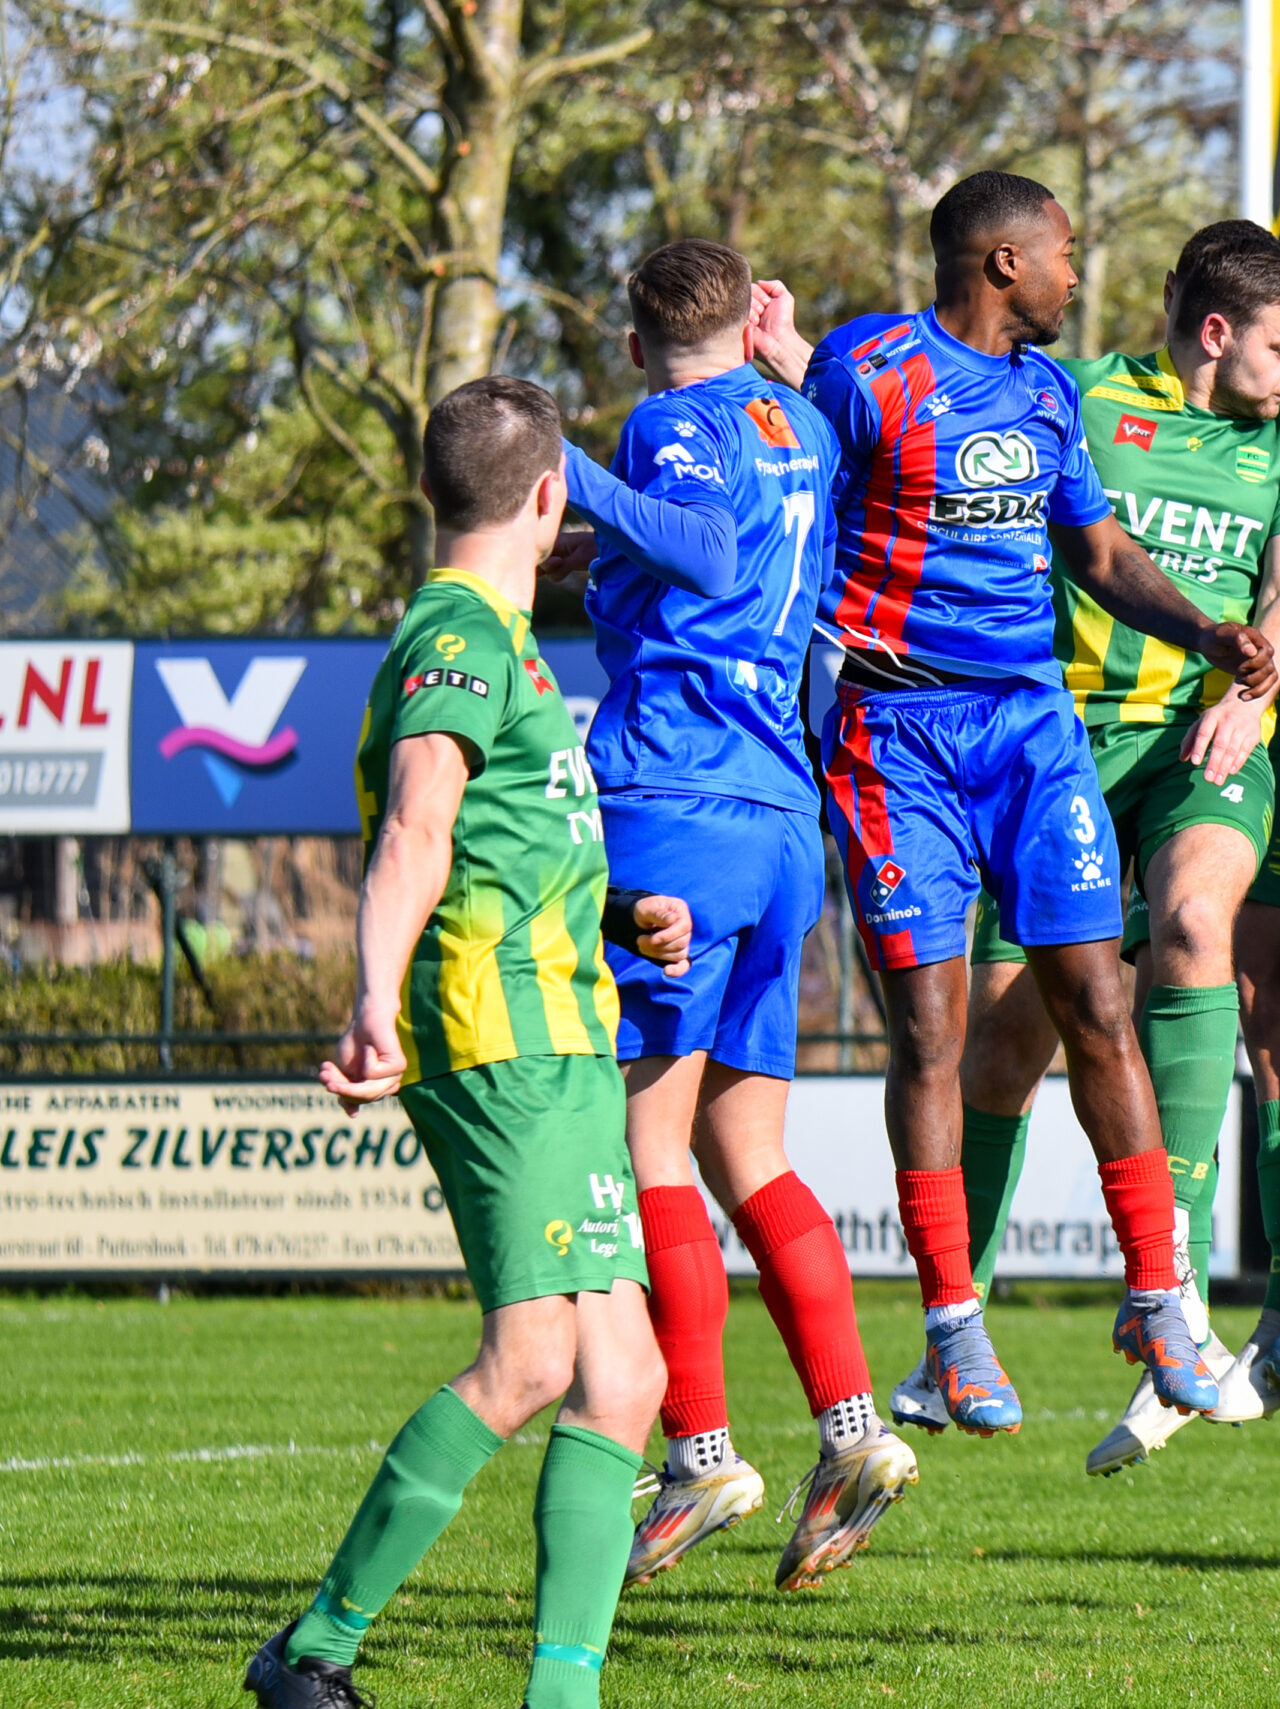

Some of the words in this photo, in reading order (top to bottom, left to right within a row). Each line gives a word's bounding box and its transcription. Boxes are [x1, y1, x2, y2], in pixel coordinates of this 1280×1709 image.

[673, 462, 725, 485] MOL
[928, 490, 1048, 529] ESDA
[772, 489, 815, 637] 7
[1148, 548, 1223, 584] RES
[1220, 783, 1244, 803] 4
[567, 809, 604, 845] TY
[1070, 795, 1097, 844] 3
[1071, 877, 1112, 892] KELME
[865, 905, 922, 924] Domino's
